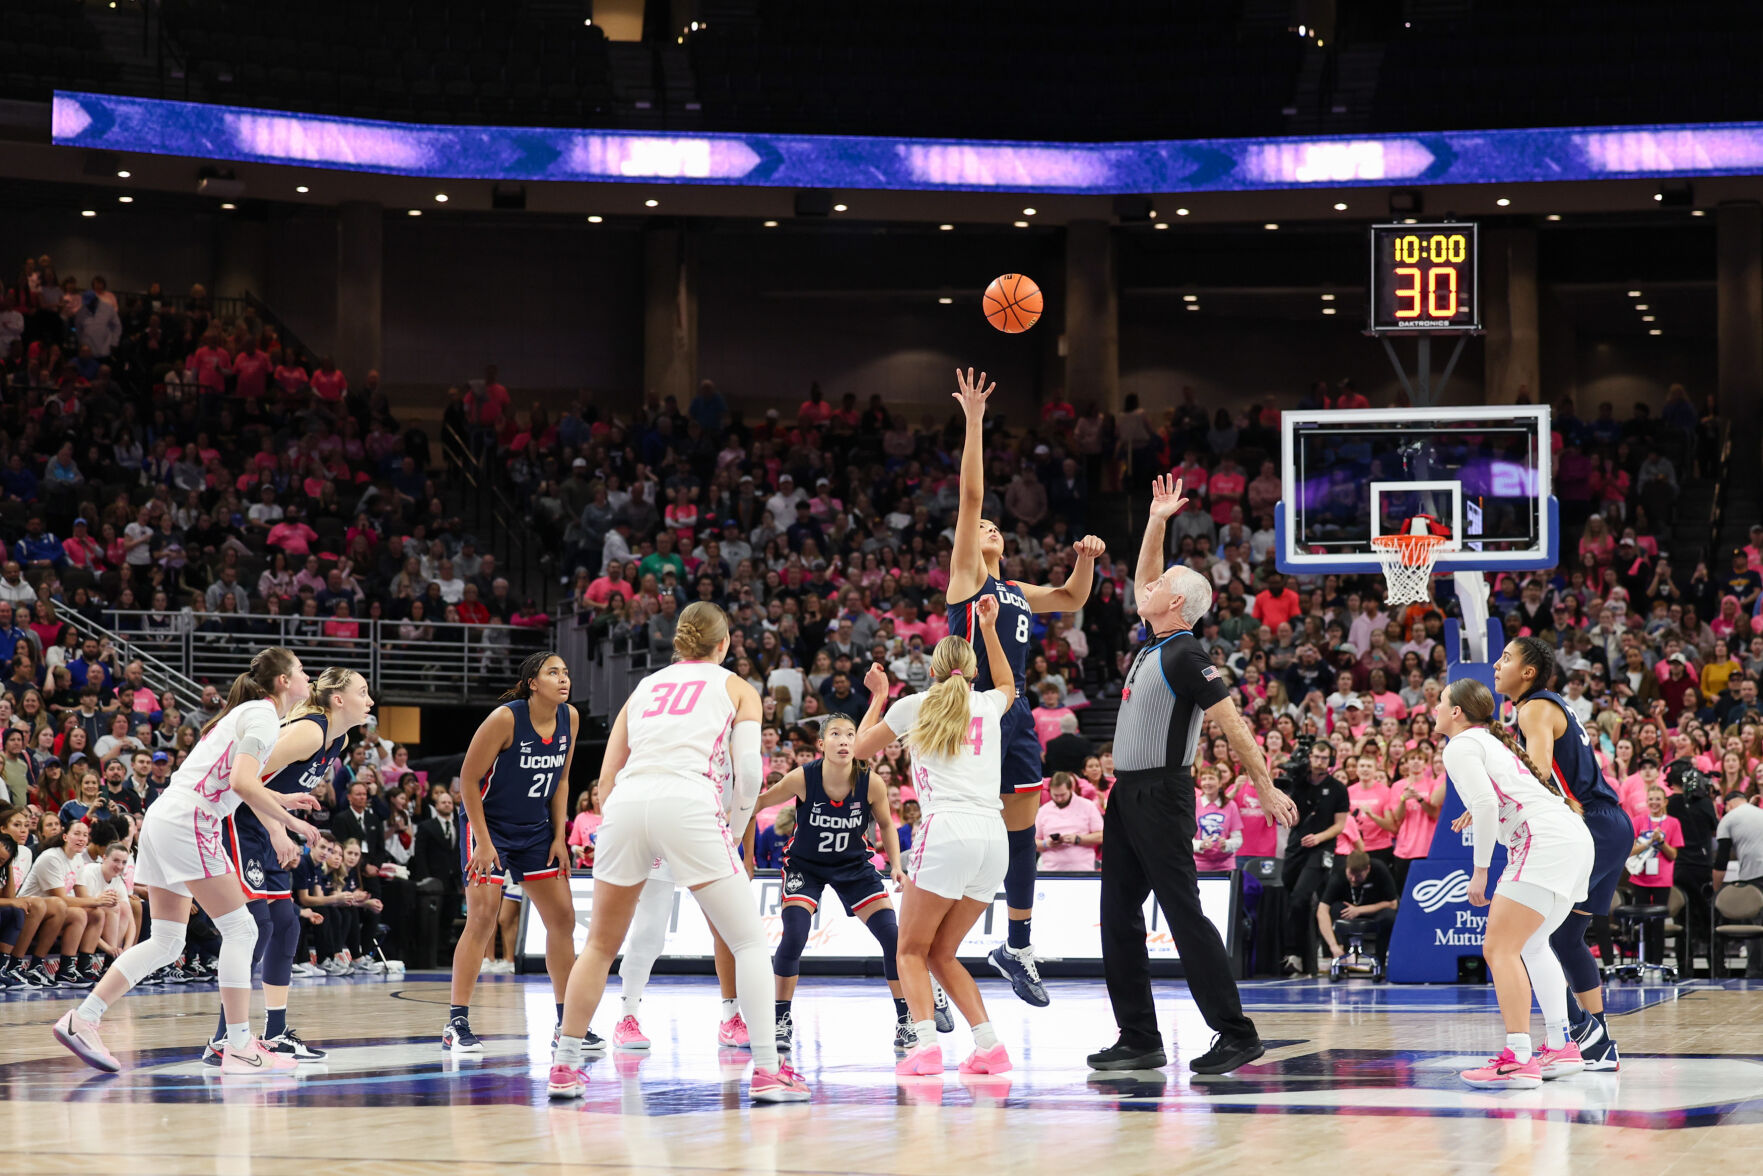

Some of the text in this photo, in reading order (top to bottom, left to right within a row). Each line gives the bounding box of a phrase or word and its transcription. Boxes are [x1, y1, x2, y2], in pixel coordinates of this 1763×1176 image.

[1394, 234, 1466, 264] 10:00
[1394, 266, 1457, 318] 30
[1015, 614, 1029, 644] 8
[642, 680, 707, 719] 30
[519, 753, 566, 769] UCONN
[527, 772, 554, 798] 21
[809, 813, 863, 829] UCONN
[818, 831, 850, 853] 20
